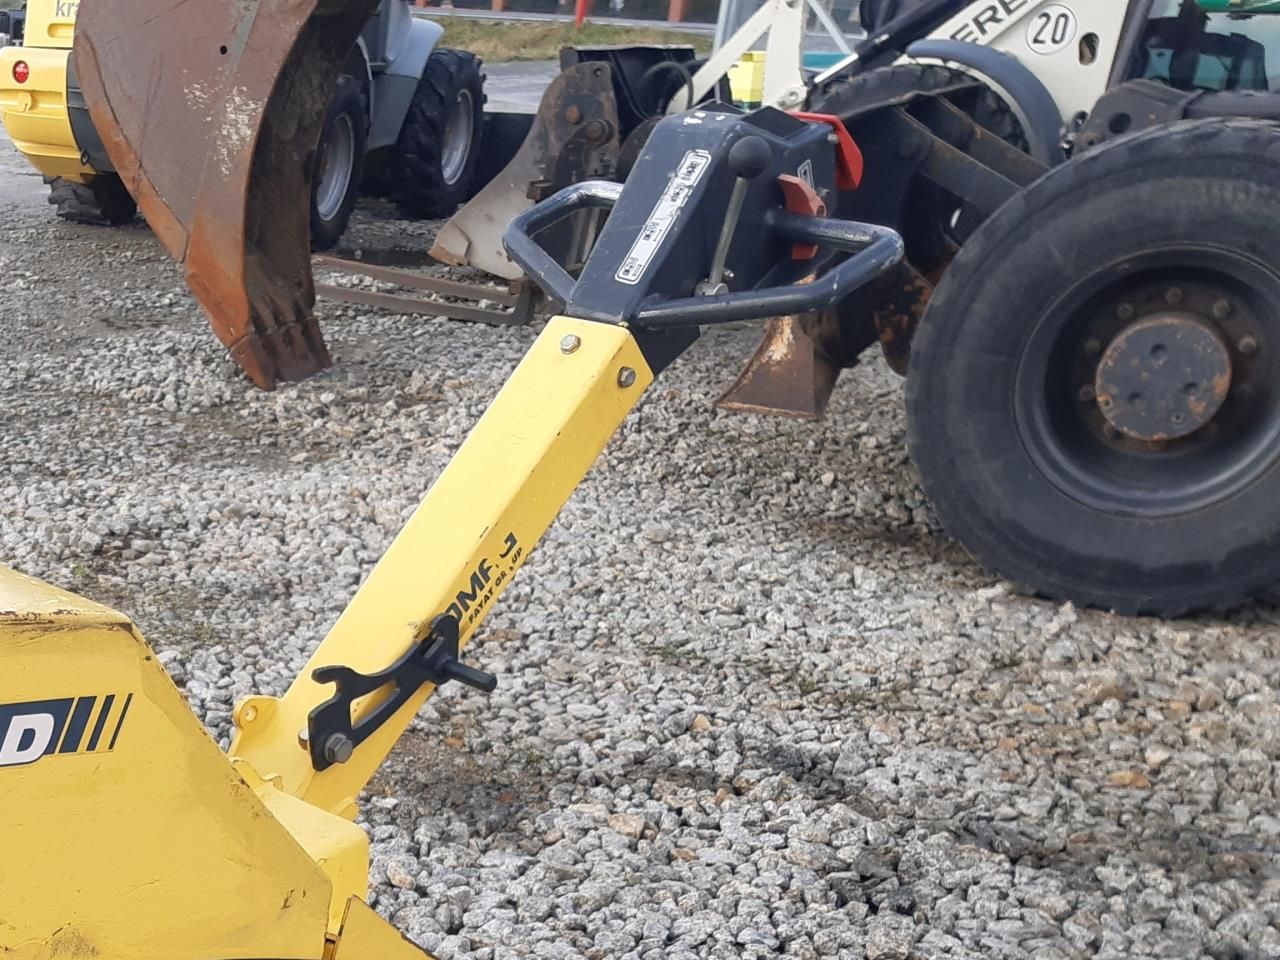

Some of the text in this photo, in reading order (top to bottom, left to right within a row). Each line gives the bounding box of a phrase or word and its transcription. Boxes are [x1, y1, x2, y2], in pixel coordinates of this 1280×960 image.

[55, 0, 79, 17] kr
[1032, 12, 1070, 45] 20
[468, 546, 523, 625] FAYAT GRUP
